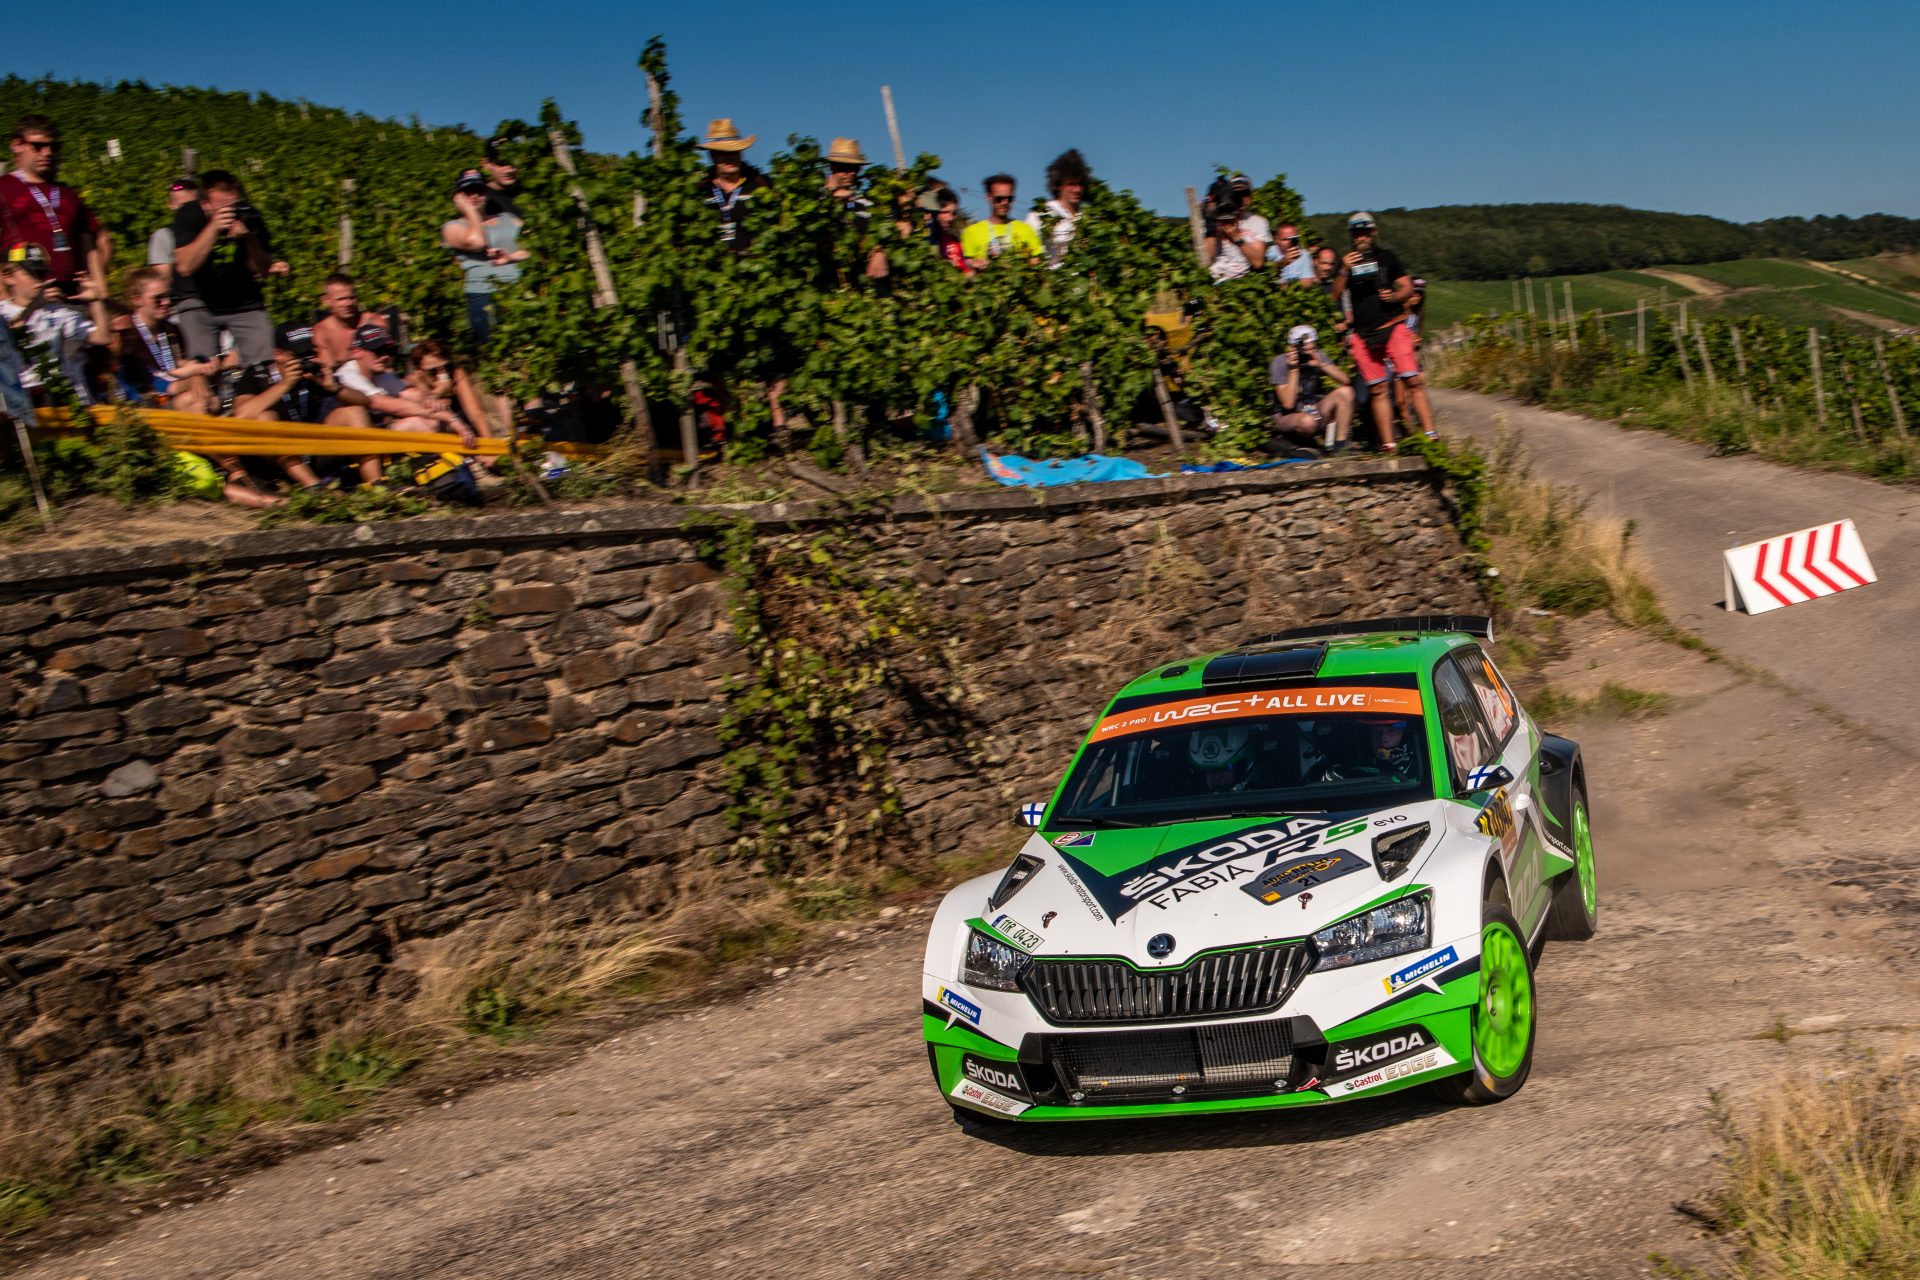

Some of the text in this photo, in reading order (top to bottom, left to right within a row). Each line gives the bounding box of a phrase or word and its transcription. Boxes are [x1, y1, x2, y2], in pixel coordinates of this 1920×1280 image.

[1265, 695, 1308, 709] ALL
[1315, 694, 1366, 707] LIVE
[1101, 723, 1119, 733] WRC
[1129, 717, 1147, 726] PRO
[1119, 819, 1332, 901] ŠKODA
[1147, 863, 1255, 911] FABIA
[1373, 813, 1408, 827] evo
[1298, 874, 1320, 888] 21
[998, 919, 1039, 949] 11R 0423
[1404, 952, 1451, 981] MICHELIN
[949, 997, 978, 1019] MICHELIN
[1335, 1032, 1425, 1071] ŠKODA
[966, 1058, 1021, 1091] ŠKODA
[1354, 1051, 1438, 1088] Castrol EDGE
[966, 1086, 1018, 1112] Castrol EDGE
